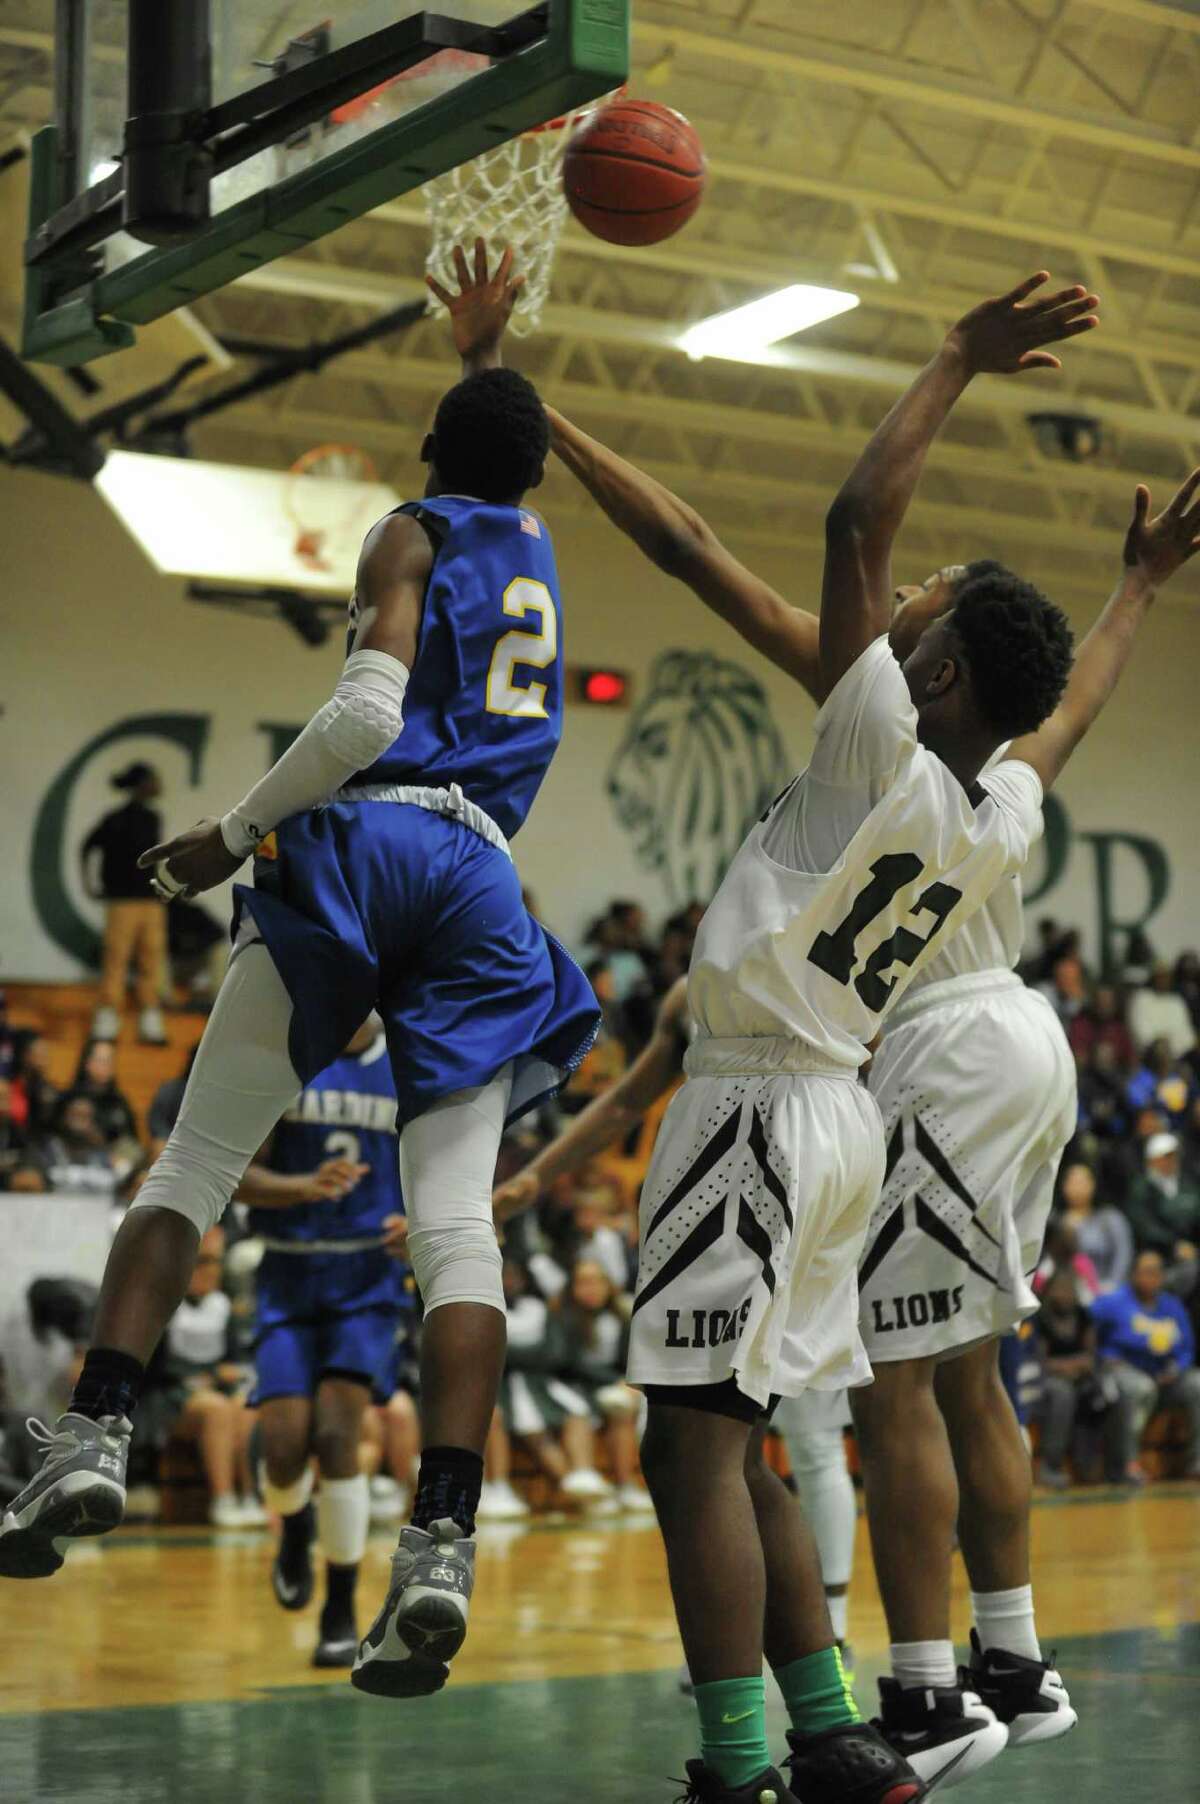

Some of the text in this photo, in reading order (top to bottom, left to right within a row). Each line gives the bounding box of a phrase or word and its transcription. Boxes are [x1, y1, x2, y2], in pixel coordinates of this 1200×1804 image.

[486, 576, 559, 718] 2
[807, 852, 963, 1013] 12
[871, 1284, 964, 1333] LIONS
